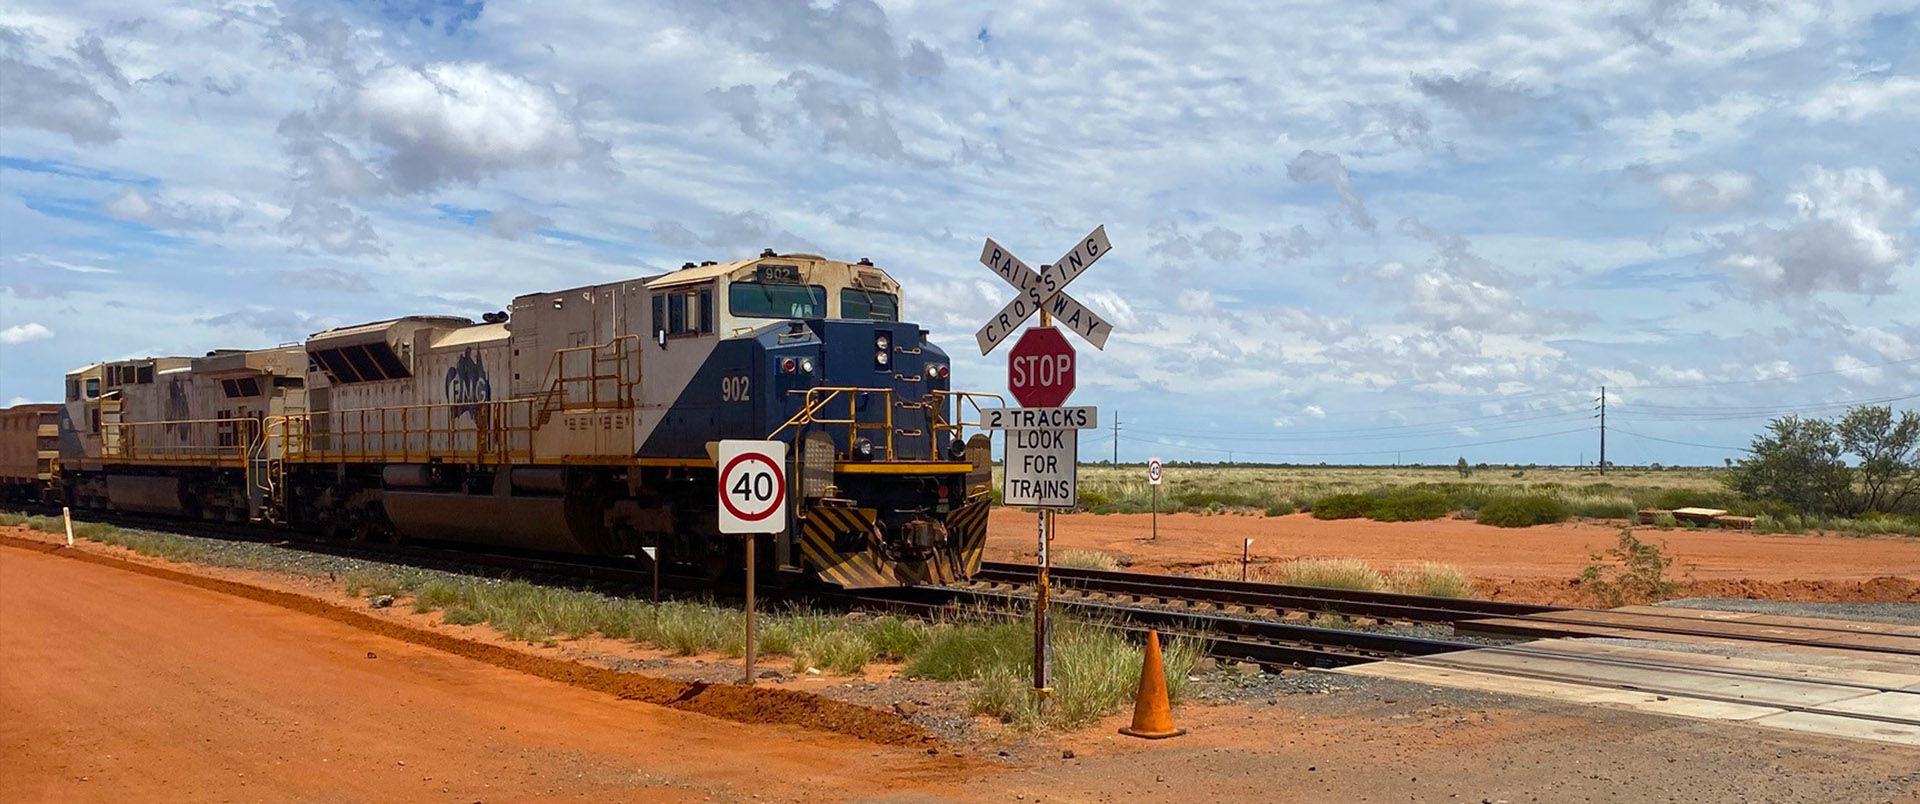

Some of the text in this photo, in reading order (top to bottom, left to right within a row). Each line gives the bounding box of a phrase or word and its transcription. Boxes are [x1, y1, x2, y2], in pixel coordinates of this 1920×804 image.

[765, 267, 791, 280] 902
[986, 238, 1099, 343] CROSSING
[990, 248, 1099, 337] RAIL WAY
[1013, 354, 1071, 388] STOP
[722, 376, 750, 402] 902
[991, 409, 1087, 428] 2 TRACKS
[1018, 430, 1064, 449] LOOK
[1024, 455, 1057, 474] FOR
[1151, 465, 1159, 476] 40
[732, 472, 773, 501] 40
[1011, 480, 1069, 499] TRAINS
